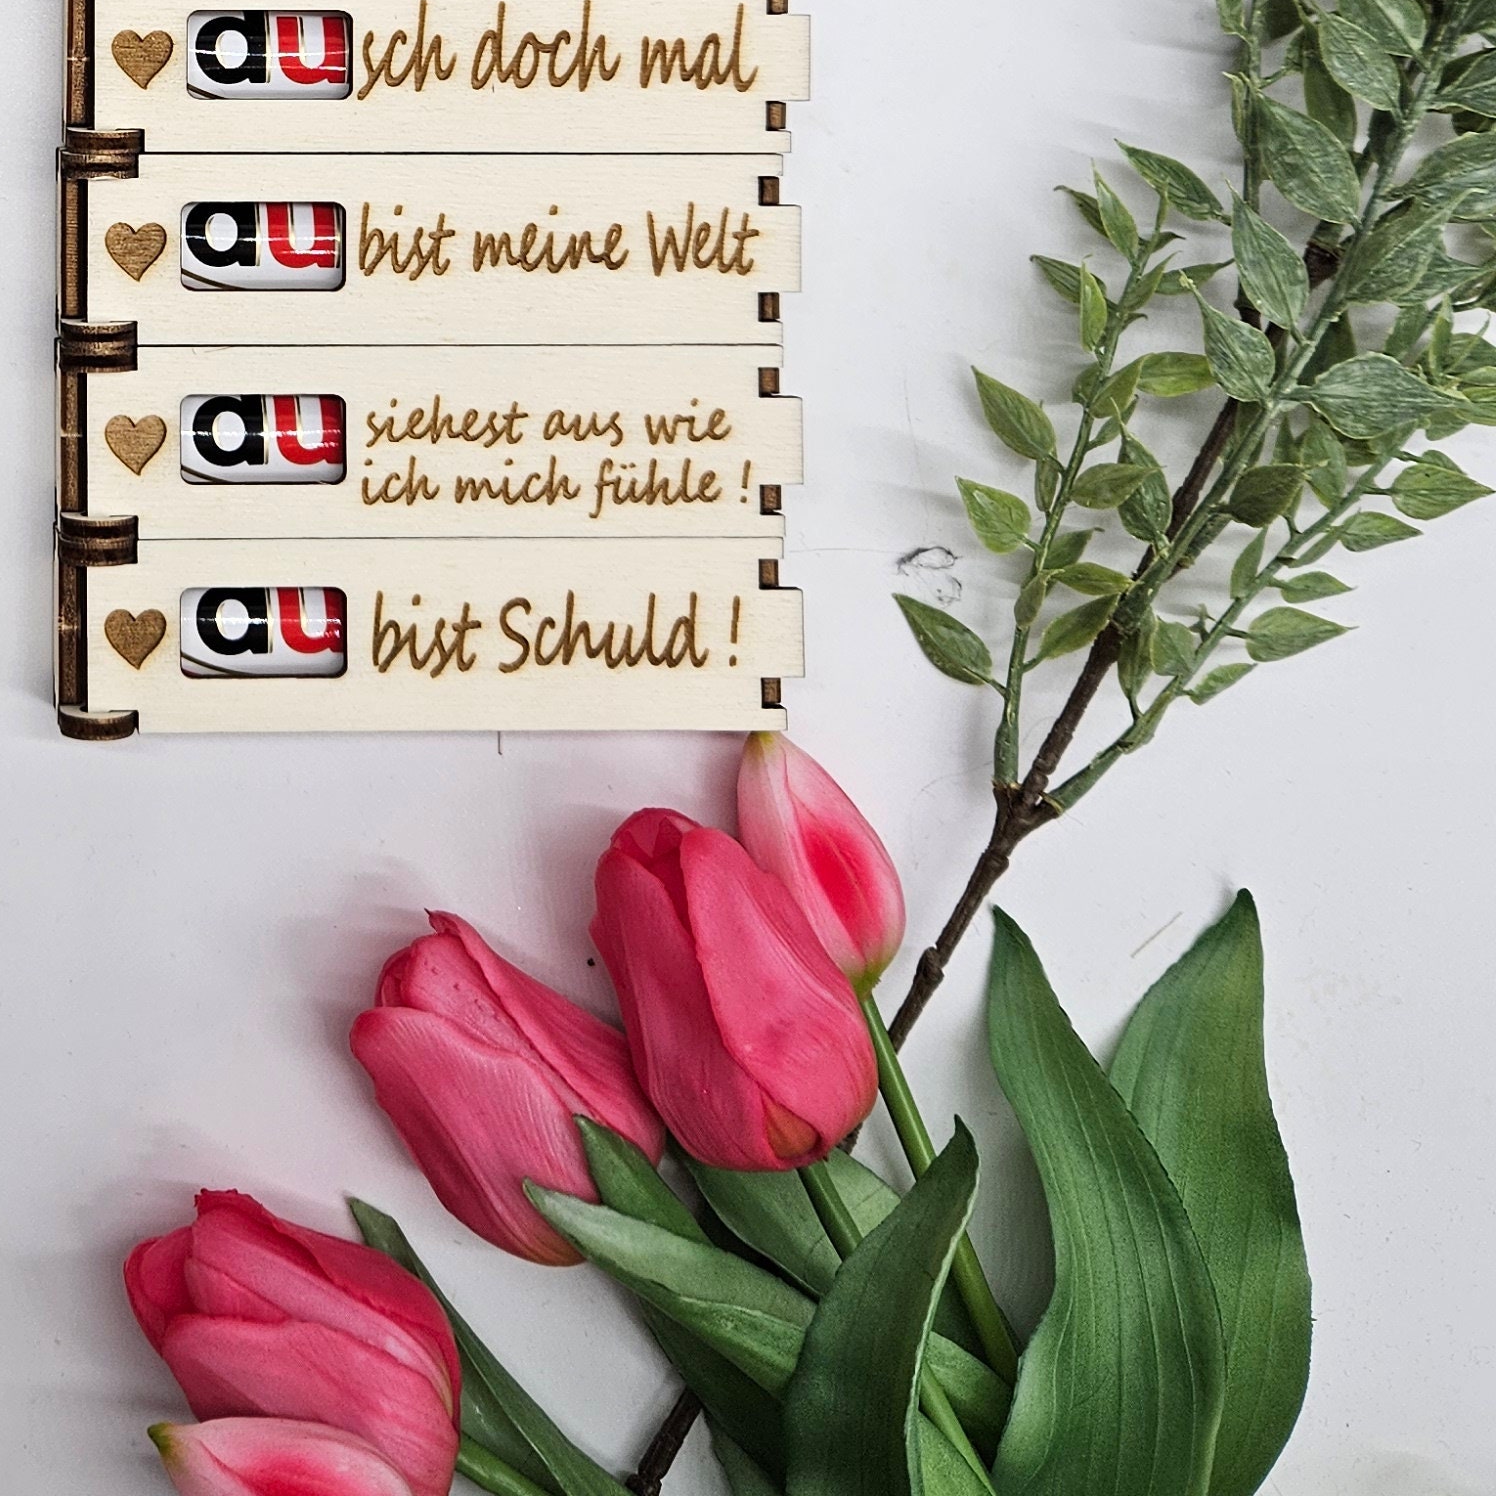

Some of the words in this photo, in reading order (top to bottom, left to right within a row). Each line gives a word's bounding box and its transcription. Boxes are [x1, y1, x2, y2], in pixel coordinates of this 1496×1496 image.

[194, 12, 350, 86] du
[639, 2, 759, 93] mal
[358, 201, 457, 282] bist
[472, 204, 630, 275] meine
[646, 201, 760, 278] Welt
[365, 393, 531, 449] siehest
[542, 409, 625, 448] aus
[643, 397, 733, 446] wie
[361, 454, 441, 507] ich
[453, 454, 582, 507] mich
[588, 457, 723, 520] fühle
[739, 459, 752, 504] !
[371, 590, 484, 680] bist
[497, 589, 710, 675] Schuld
[728, 595, 742, 668] !
